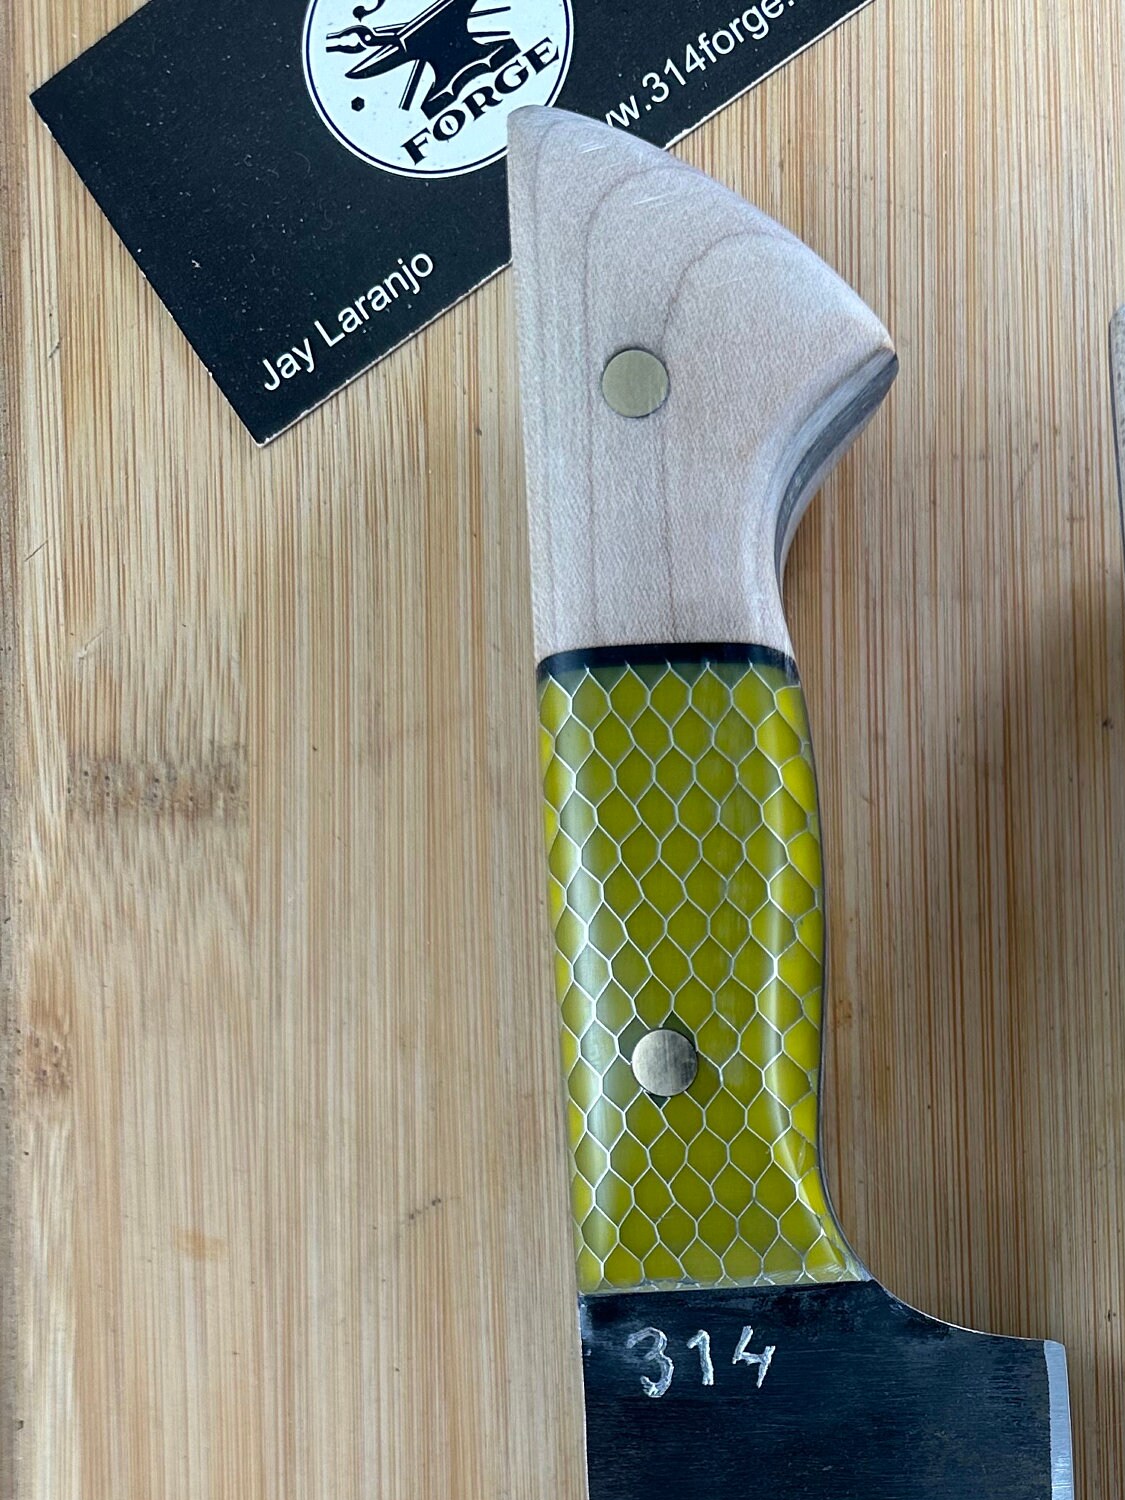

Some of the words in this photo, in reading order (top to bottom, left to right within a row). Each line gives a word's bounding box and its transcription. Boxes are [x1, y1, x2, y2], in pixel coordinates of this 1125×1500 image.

[401, 37, 560, 165] FORGE
[605, 0, 795, 127] w.314forge.
[262, 338, 315, 391] Jay
[314, 253, 434, 347] Laranjo
[626, 1325, 776, 1398] 314
